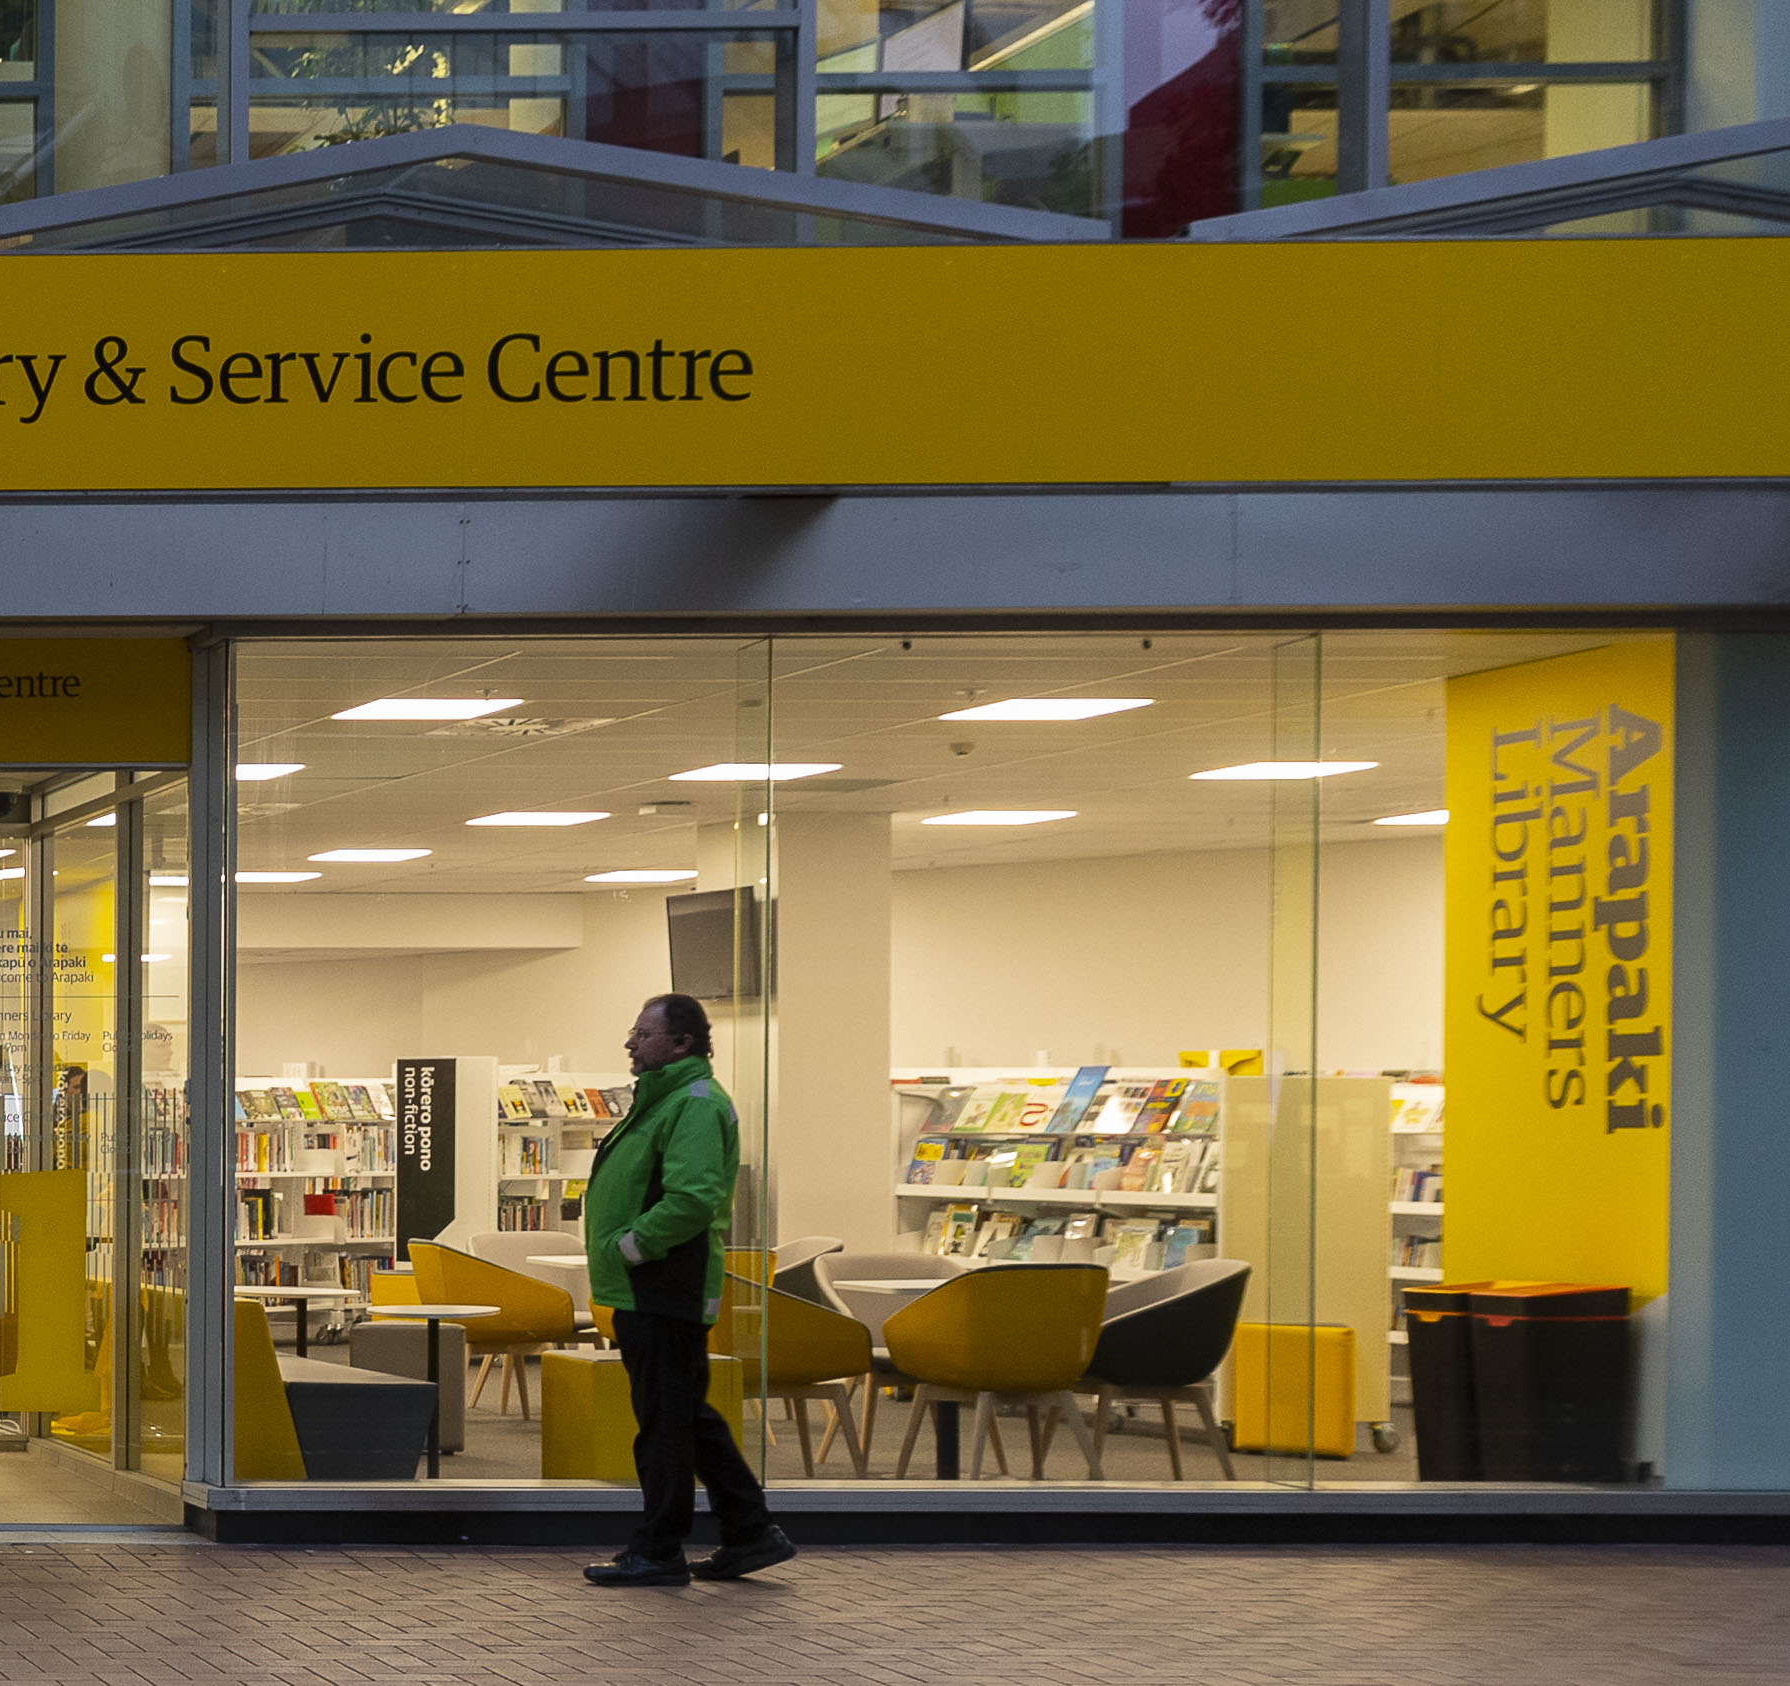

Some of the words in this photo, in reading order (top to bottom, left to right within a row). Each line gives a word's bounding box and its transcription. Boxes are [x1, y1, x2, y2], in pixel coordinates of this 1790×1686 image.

[84, 335, 147, 406] &
[170, 332, 465, 405] Service
[487, 333, 754, 403] Centre
[1478, 718, 1545, 1043] Library
[1545, 708, 1602, 1110] Manners
[1593, 703, 1665, 1135] Arapaki
[51, 972, 94, 984] Arapaki
[404, 1067, 418, 1155] non-fiction
[420, 1067, 435, 1124] kōrero
[418, 1126, 431, 1171] pono
